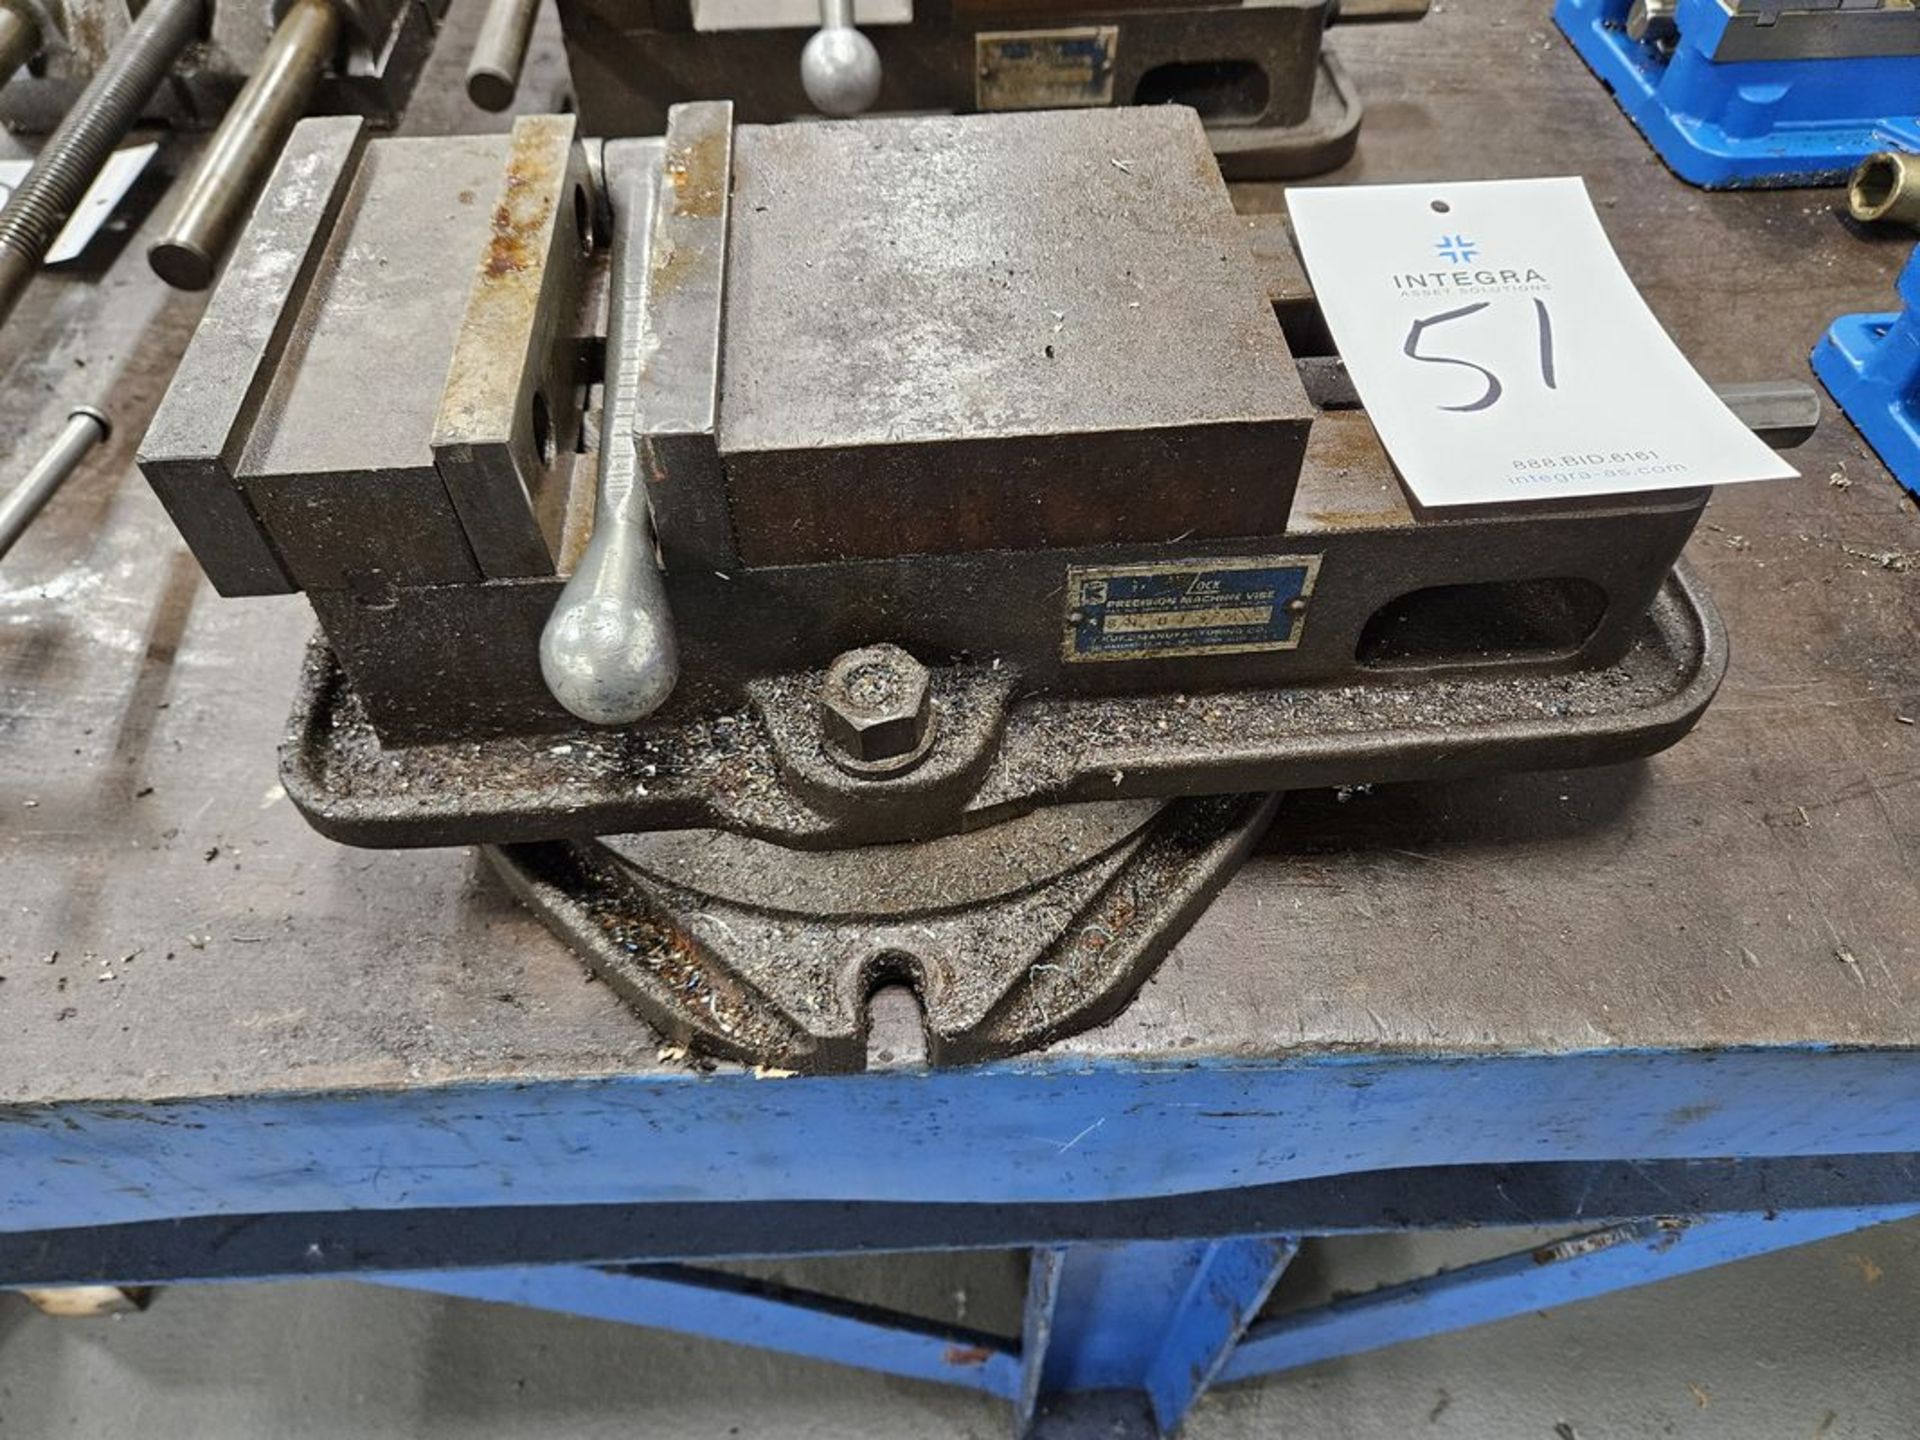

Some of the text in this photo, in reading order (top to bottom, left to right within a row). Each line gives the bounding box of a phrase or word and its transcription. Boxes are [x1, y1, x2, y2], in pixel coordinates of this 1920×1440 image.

[1393, 269, 1548, 288] INTEGRA
[1400, 283, 1553, 298] ASSET SOLUTIONS
[1403, 297, 1557, 412] 51
[1512, 450, 1660, 471] 888.BID.6161
[1508, 462, 1688, 486] integra-as.com
